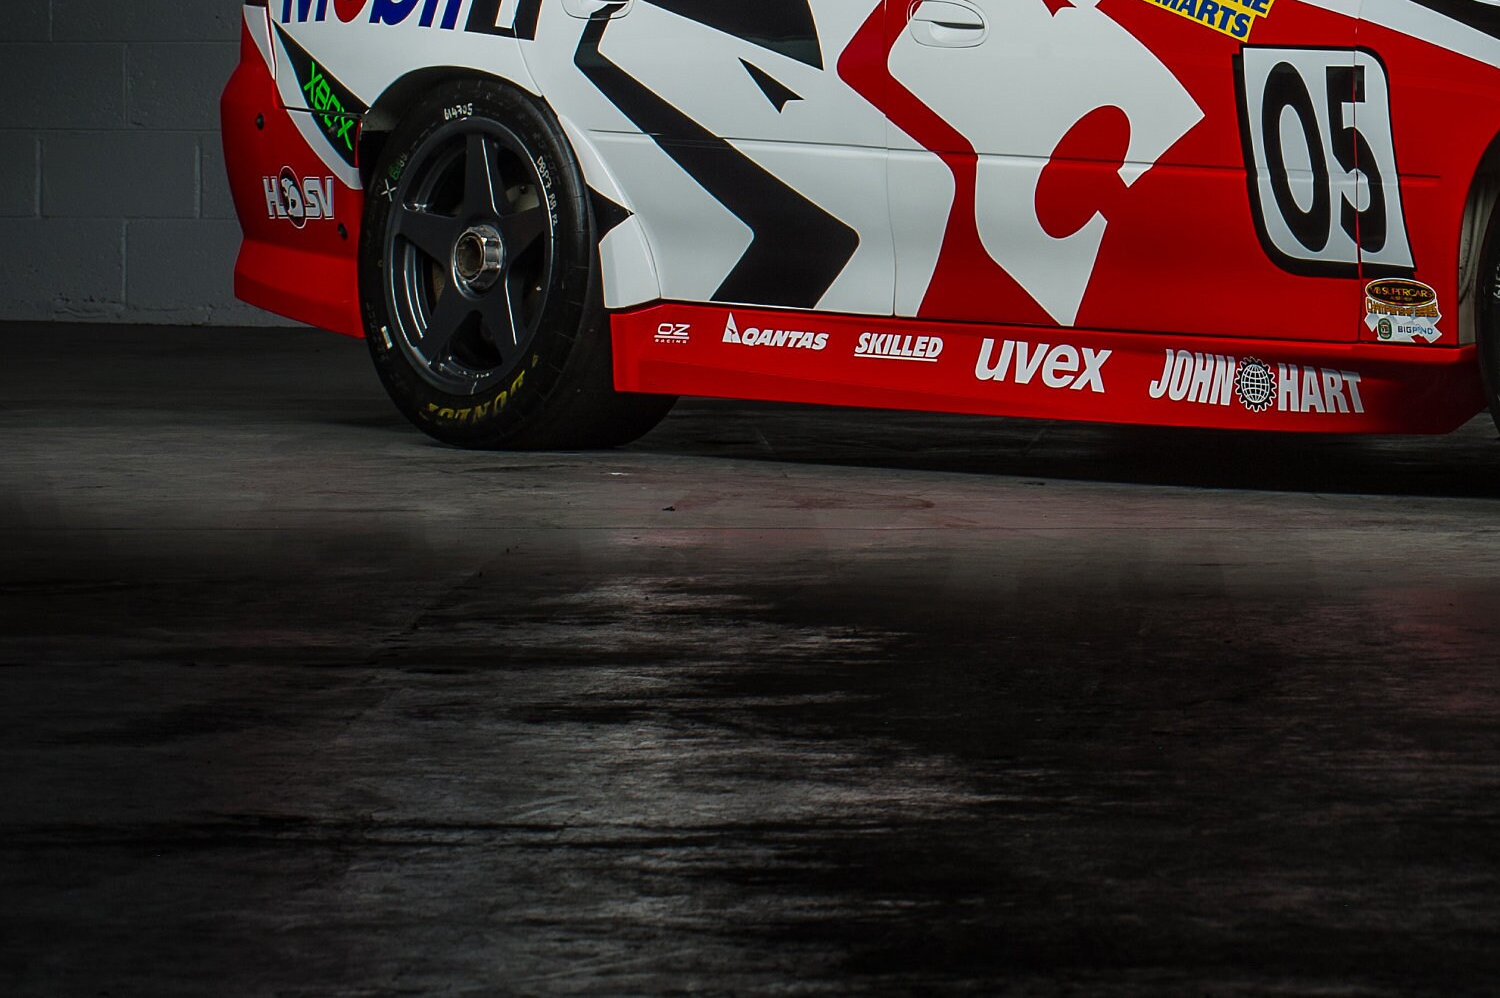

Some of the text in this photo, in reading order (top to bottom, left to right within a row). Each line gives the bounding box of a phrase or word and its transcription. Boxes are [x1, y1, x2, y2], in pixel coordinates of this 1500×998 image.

[1261, 61, 1387, 254] 05
[741, 327, 829, 351] QANTAS
[854, 332, 944, 359] SKILLED
[974, 337, 1113, 394] uvex
[1148, 348, 1365, 414] JOHN HART
